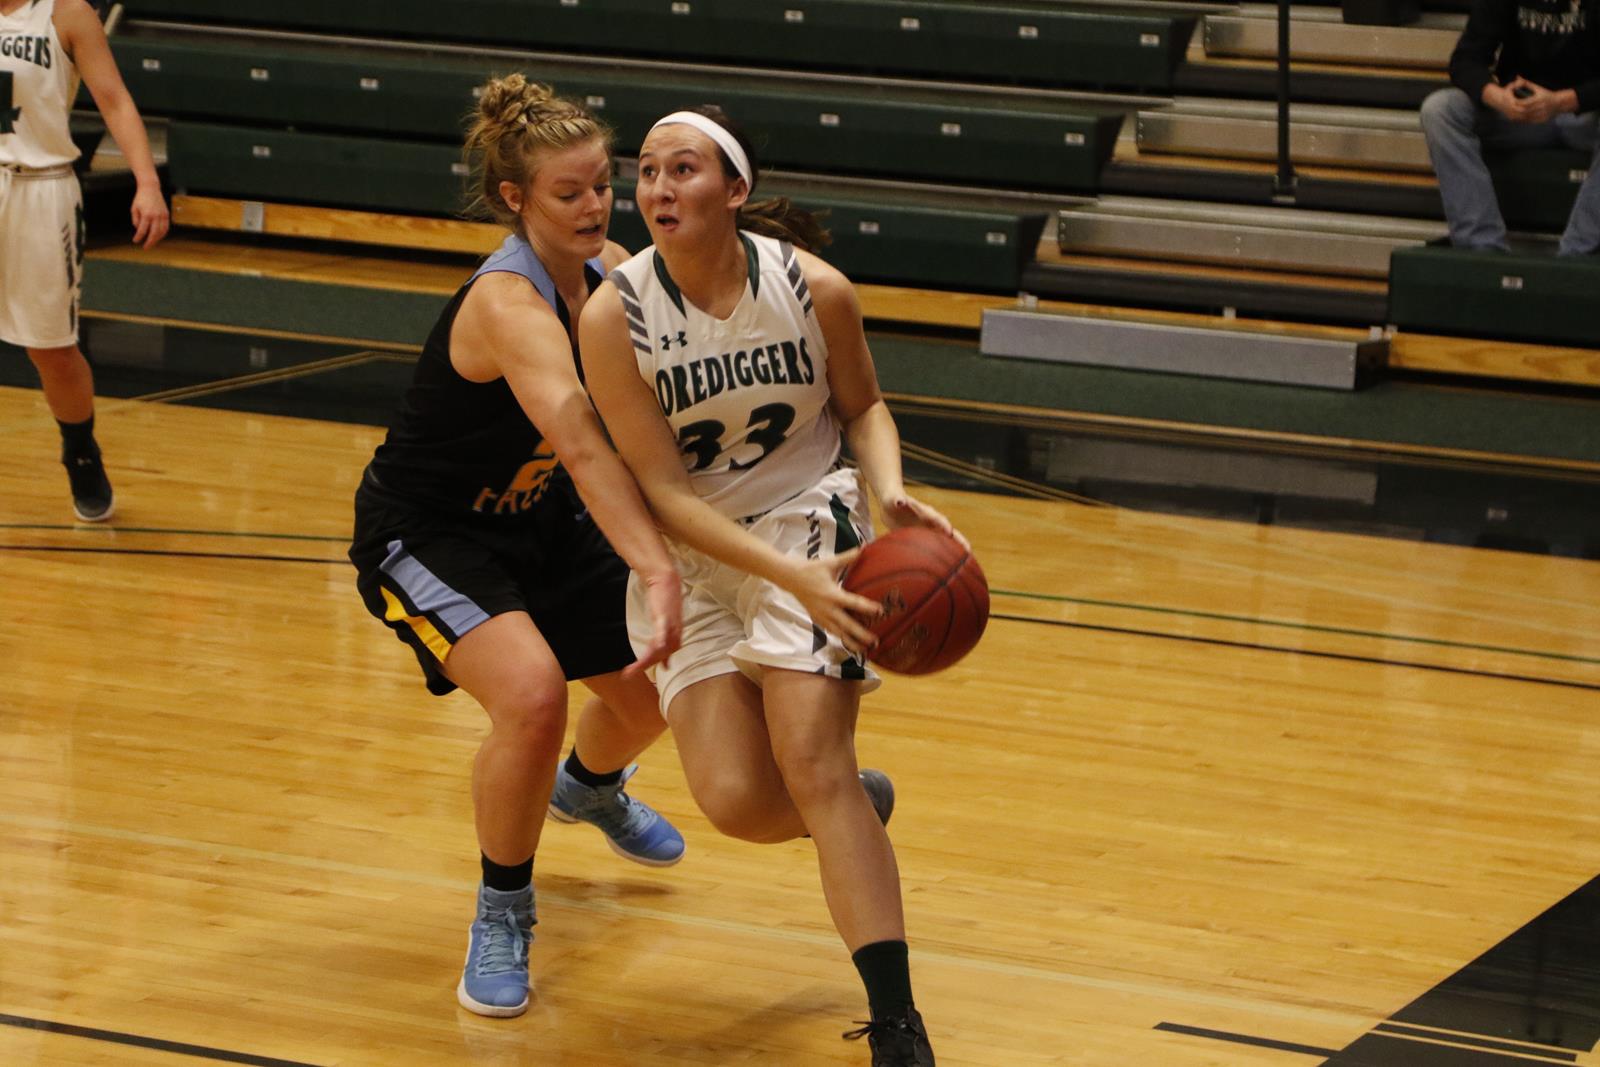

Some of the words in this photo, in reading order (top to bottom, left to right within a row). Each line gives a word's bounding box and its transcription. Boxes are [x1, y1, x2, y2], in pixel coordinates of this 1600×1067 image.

[0, 35, 51, 69] GGERS
[655, 336, 815, 417] OREDIGGERS
[677, 402, 796, 471] 33
